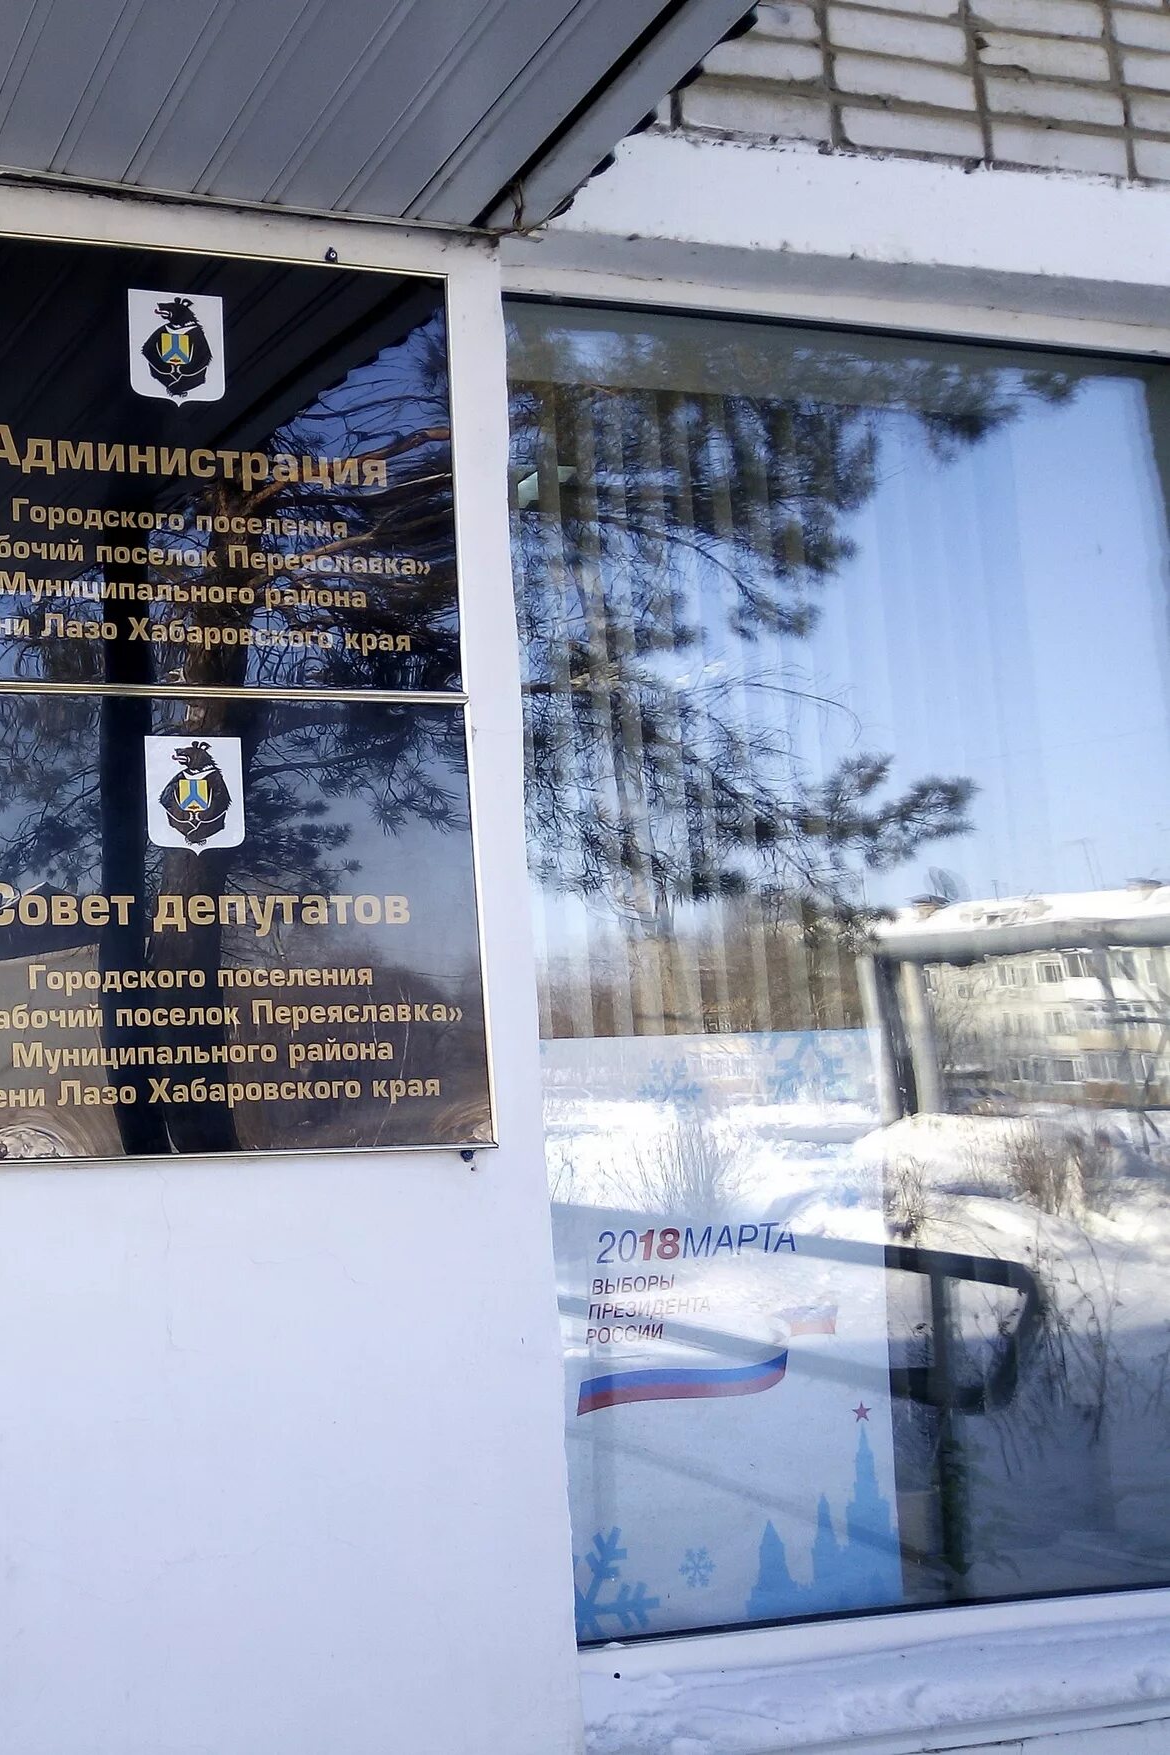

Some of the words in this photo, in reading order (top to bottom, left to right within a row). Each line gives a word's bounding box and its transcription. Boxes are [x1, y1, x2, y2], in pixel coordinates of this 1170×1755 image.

[12, 497, 185, 533] Городского
[196, 513, 348, 539] поселения
[96, 544, 216, 568] поселок
[228, 543, 431, 576] Переяславка»
[264, 583, 367, 611] района
[41, 613, 118, 641] Лазо
[128, 616, 334, 651] Хабаровского
[344, 631, 411, 656] края
[153, 892, 411, 937] депутатов
[27, 964, 206, 995] Городского
[217, 964, 373, 989] поселения
[115, 1007, 239, 1028] поселок
[251, 999, 463, 1031] Переяславка»
[12, 1040, 277, 1074] Муниципального
[288, 1039, 394, 1068] района
[56, 1080, 137, 1107] Лазо
[148, 1076, 362, 1109] Хабаровского
[372, 1077, 441, 1103] края
[592, 1274, 675, 1295] ВЫБОРЫ
[588, 1297, 711, 1320] ПРЕЗИДЕНТА
[585, 1323, 664, 1345] РОССИИ
